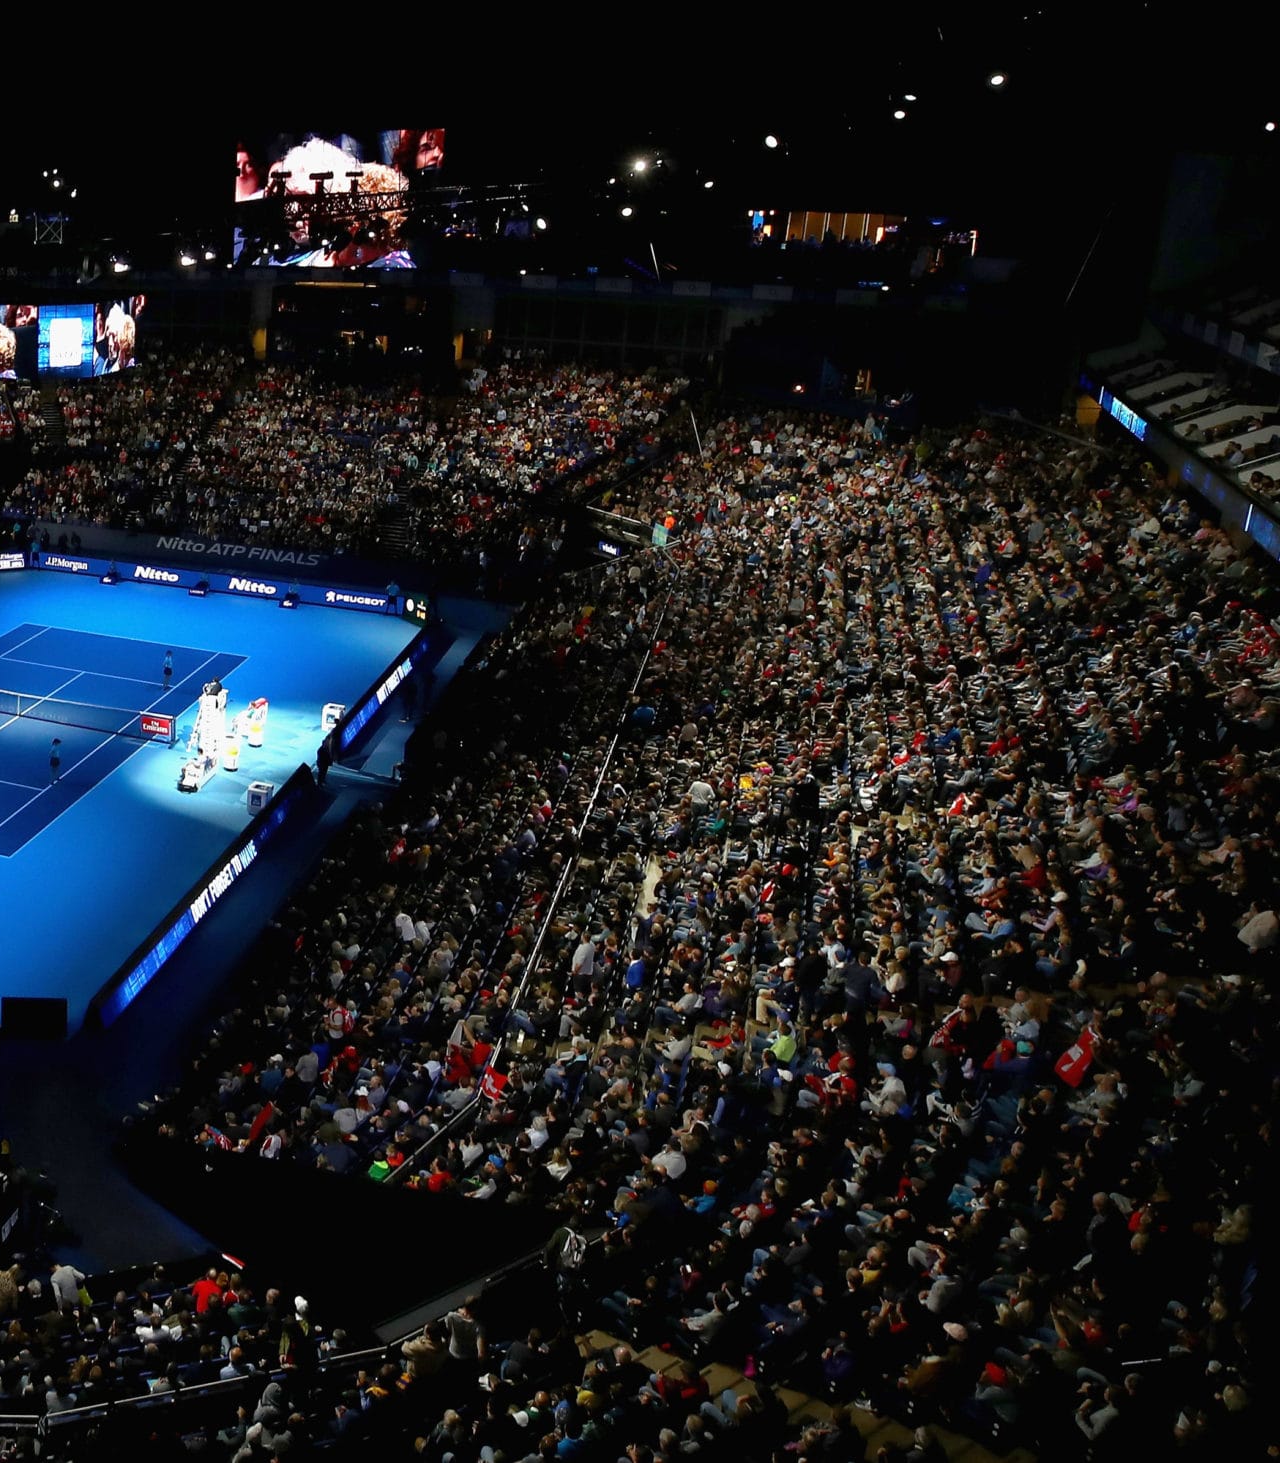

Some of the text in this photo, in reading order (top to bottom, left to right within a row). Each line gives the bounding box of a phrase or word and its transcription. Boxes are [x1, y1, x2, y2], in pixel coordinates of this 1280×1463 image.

[156, 536, 321, 567] Nitto ATP FINALS
[45, 556, 88, 572] J.P.Morgan
[134, 566, 179, 582] Nitto
[228, 577, 277, 595] Nitto
[335, 593, 387, 607] PEUGEOT
